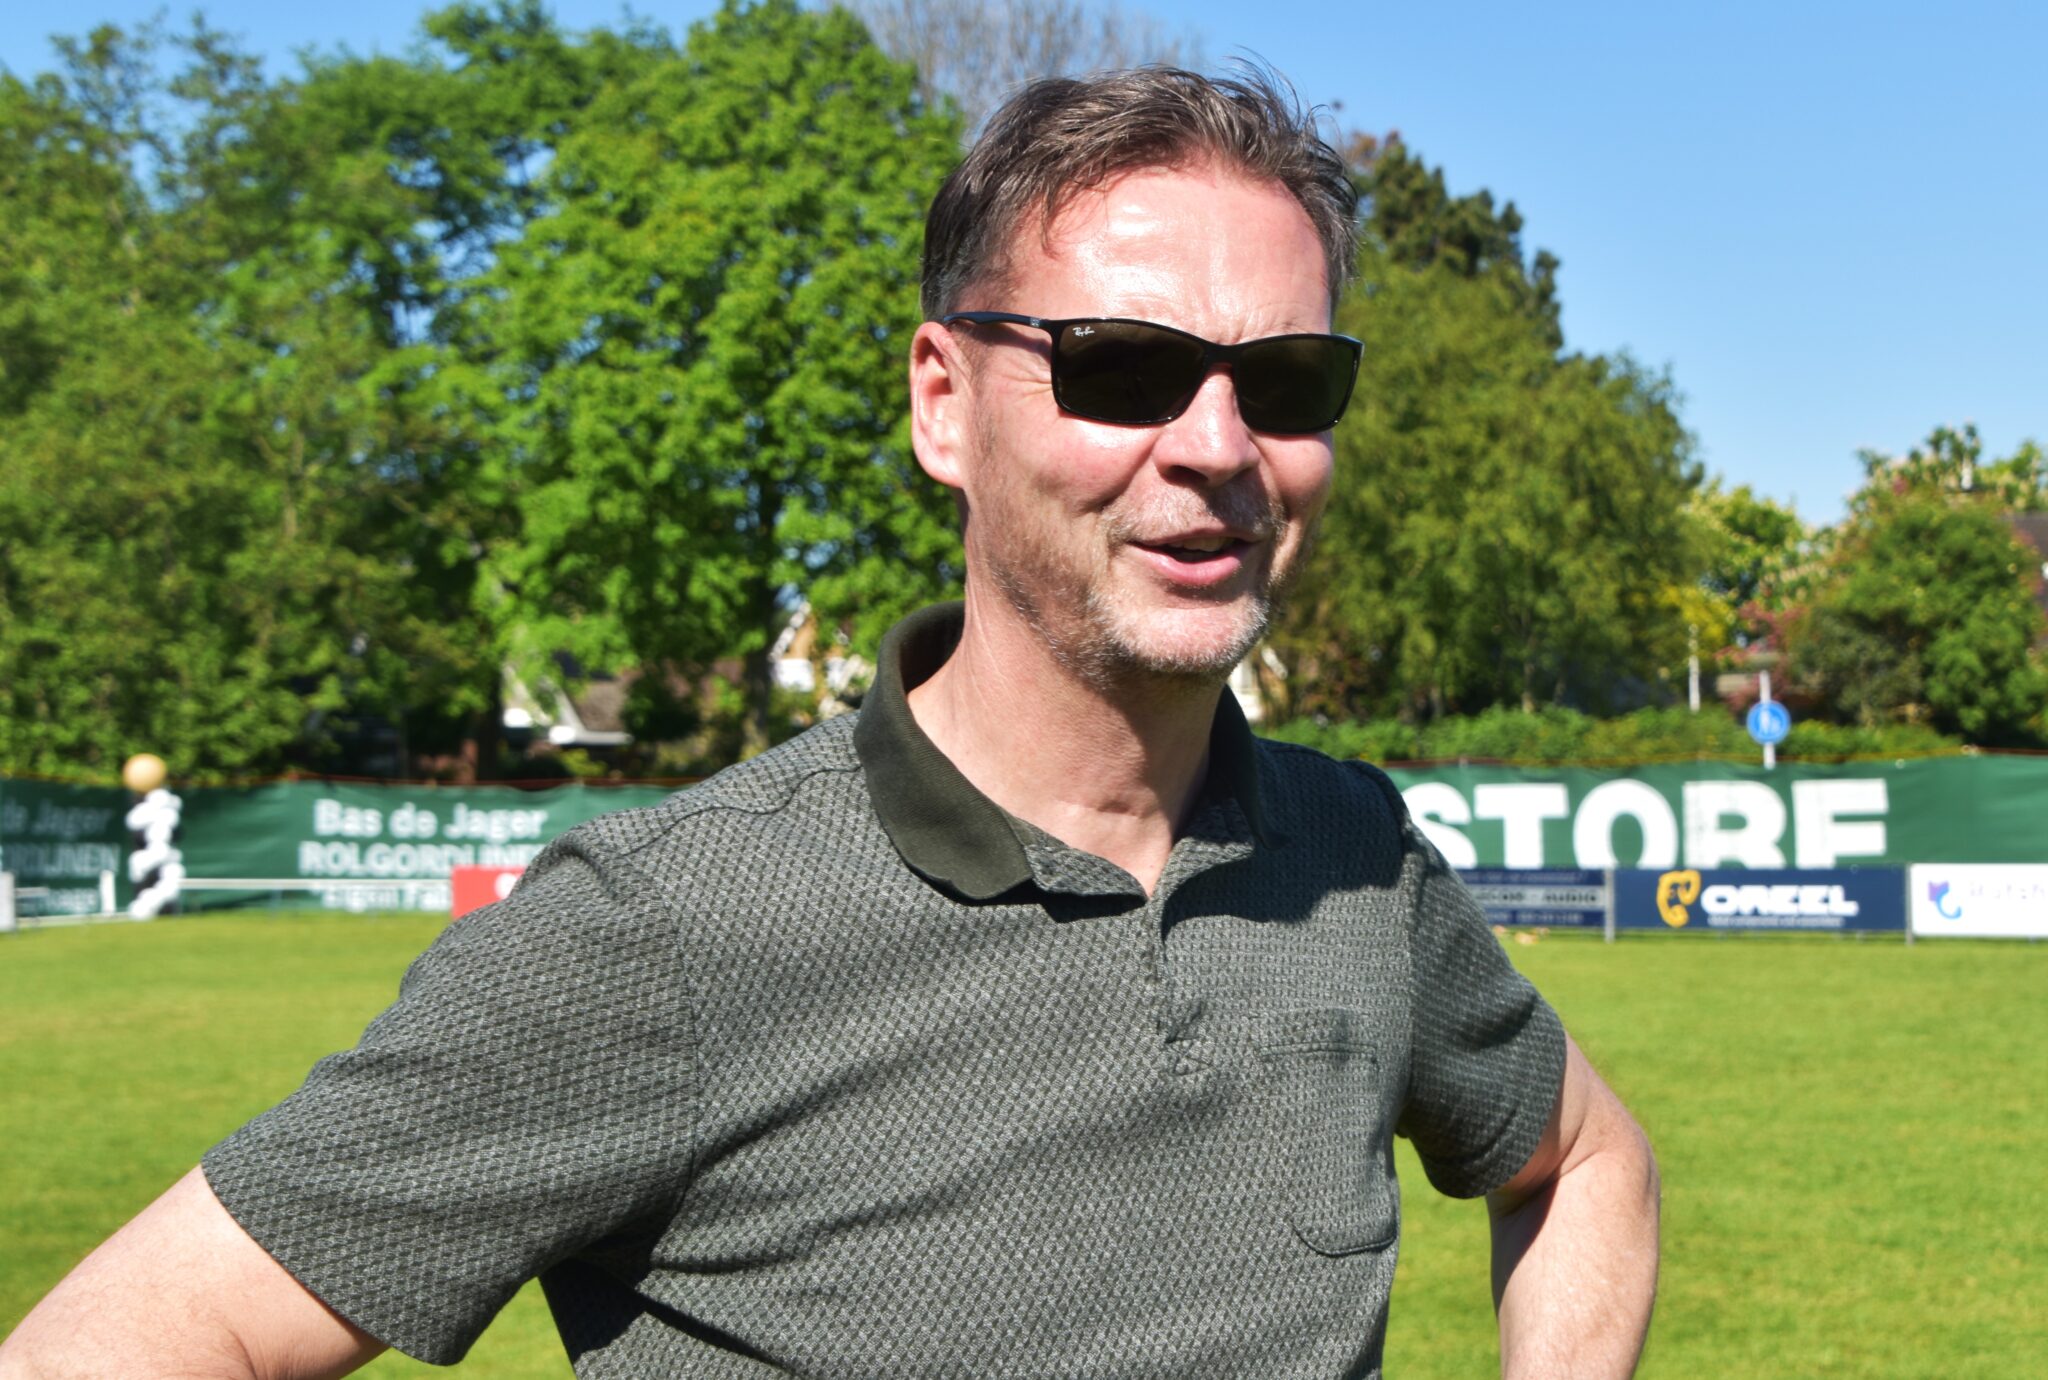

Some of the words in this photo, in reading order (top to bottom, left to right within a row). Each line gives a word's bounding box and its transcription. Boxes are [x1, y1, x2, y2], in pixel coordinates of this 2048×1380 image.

[314, 798, 383, 837] Bas
[389, 801, 438, 838] de
[443, 802, 550, 844] Jager
